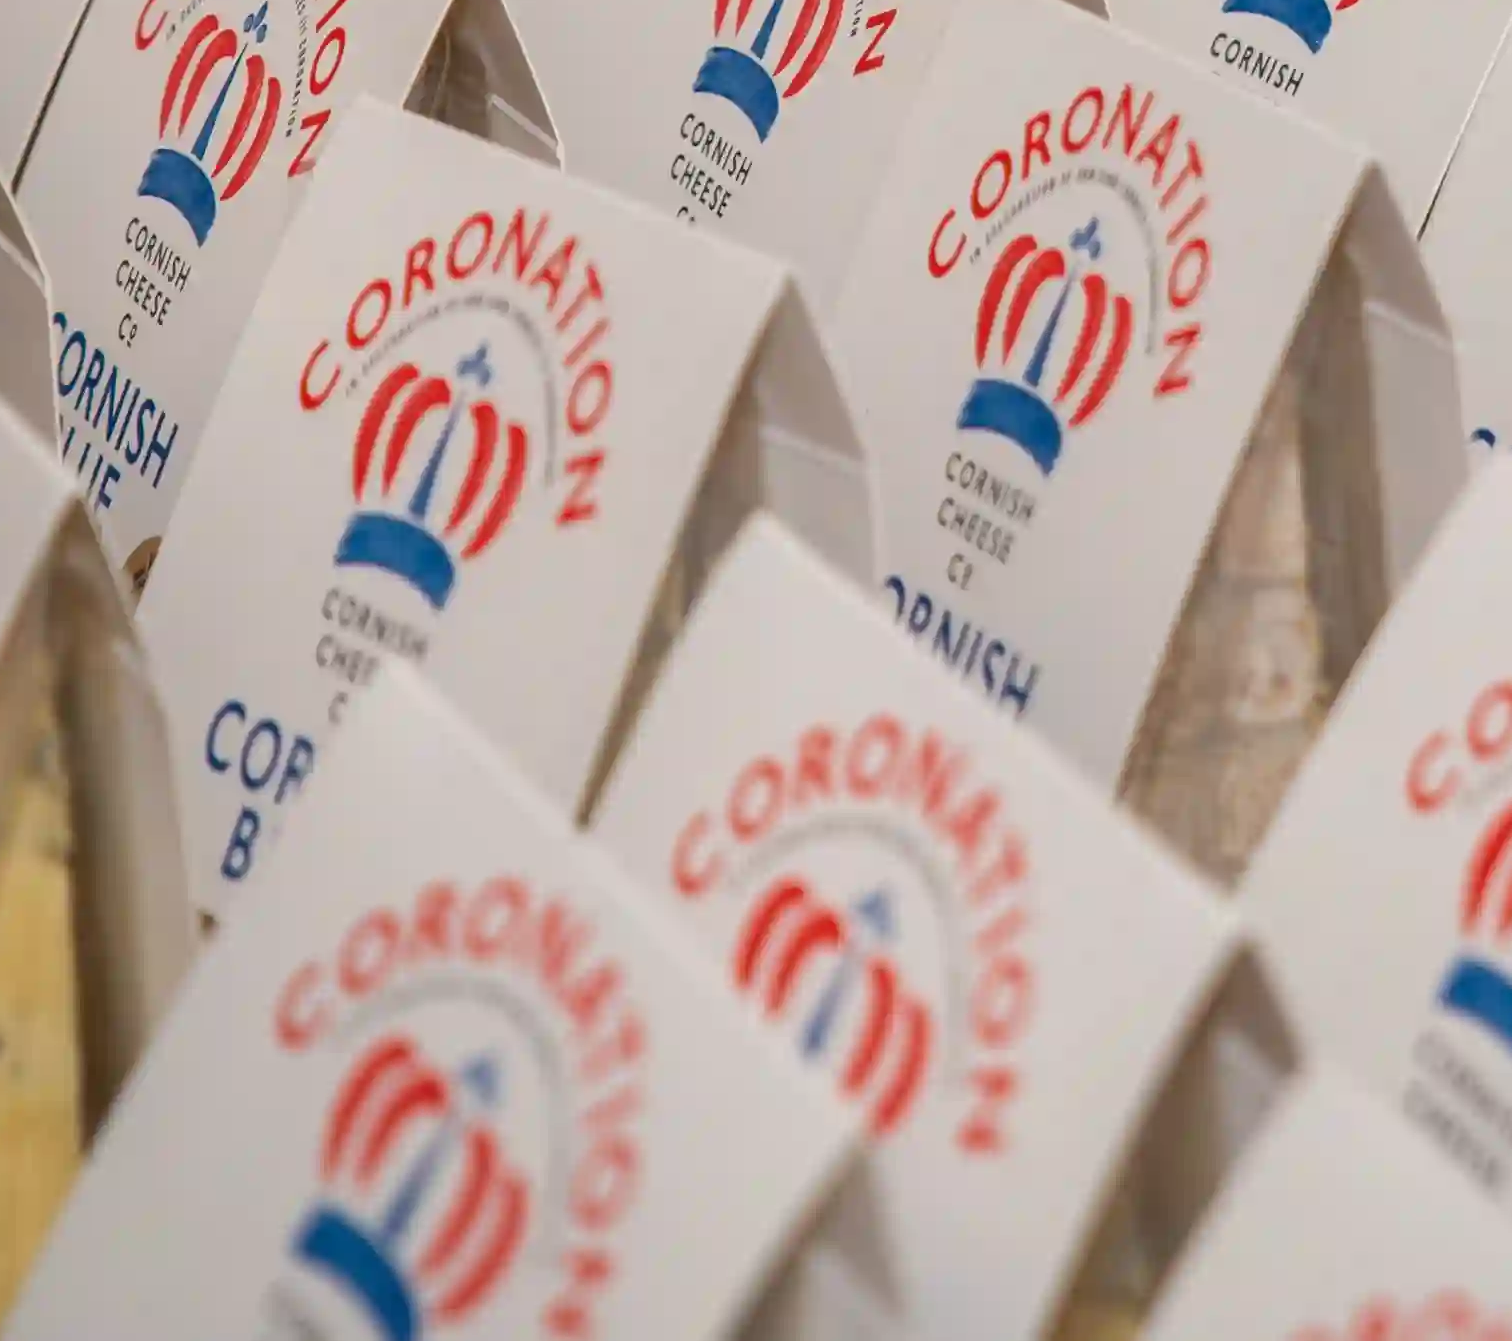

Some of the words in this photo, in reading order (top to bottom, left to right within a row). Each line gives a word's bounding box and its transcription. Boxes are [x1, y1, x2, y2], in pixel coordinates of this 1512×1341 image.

[1210, 33, 1304, 97] CORNISH
[680, 113, 753, 185] CORNISH
[670, 154, 732, 219] CHEESE
[125, 217, 191, 293] CORNISH
[928, 83, 1212, 397] CORONATION
[116, 259, 173, 326] CHEESE
[299, 208, 612, 527] CORONATION
[944, 450, 1037, 522] CORNISH
[936, 496, 1016, 566] CHEESE
[671, 712, 1033, 1156] CORONATION
[273, 876, 650, 1341] CORONATION
